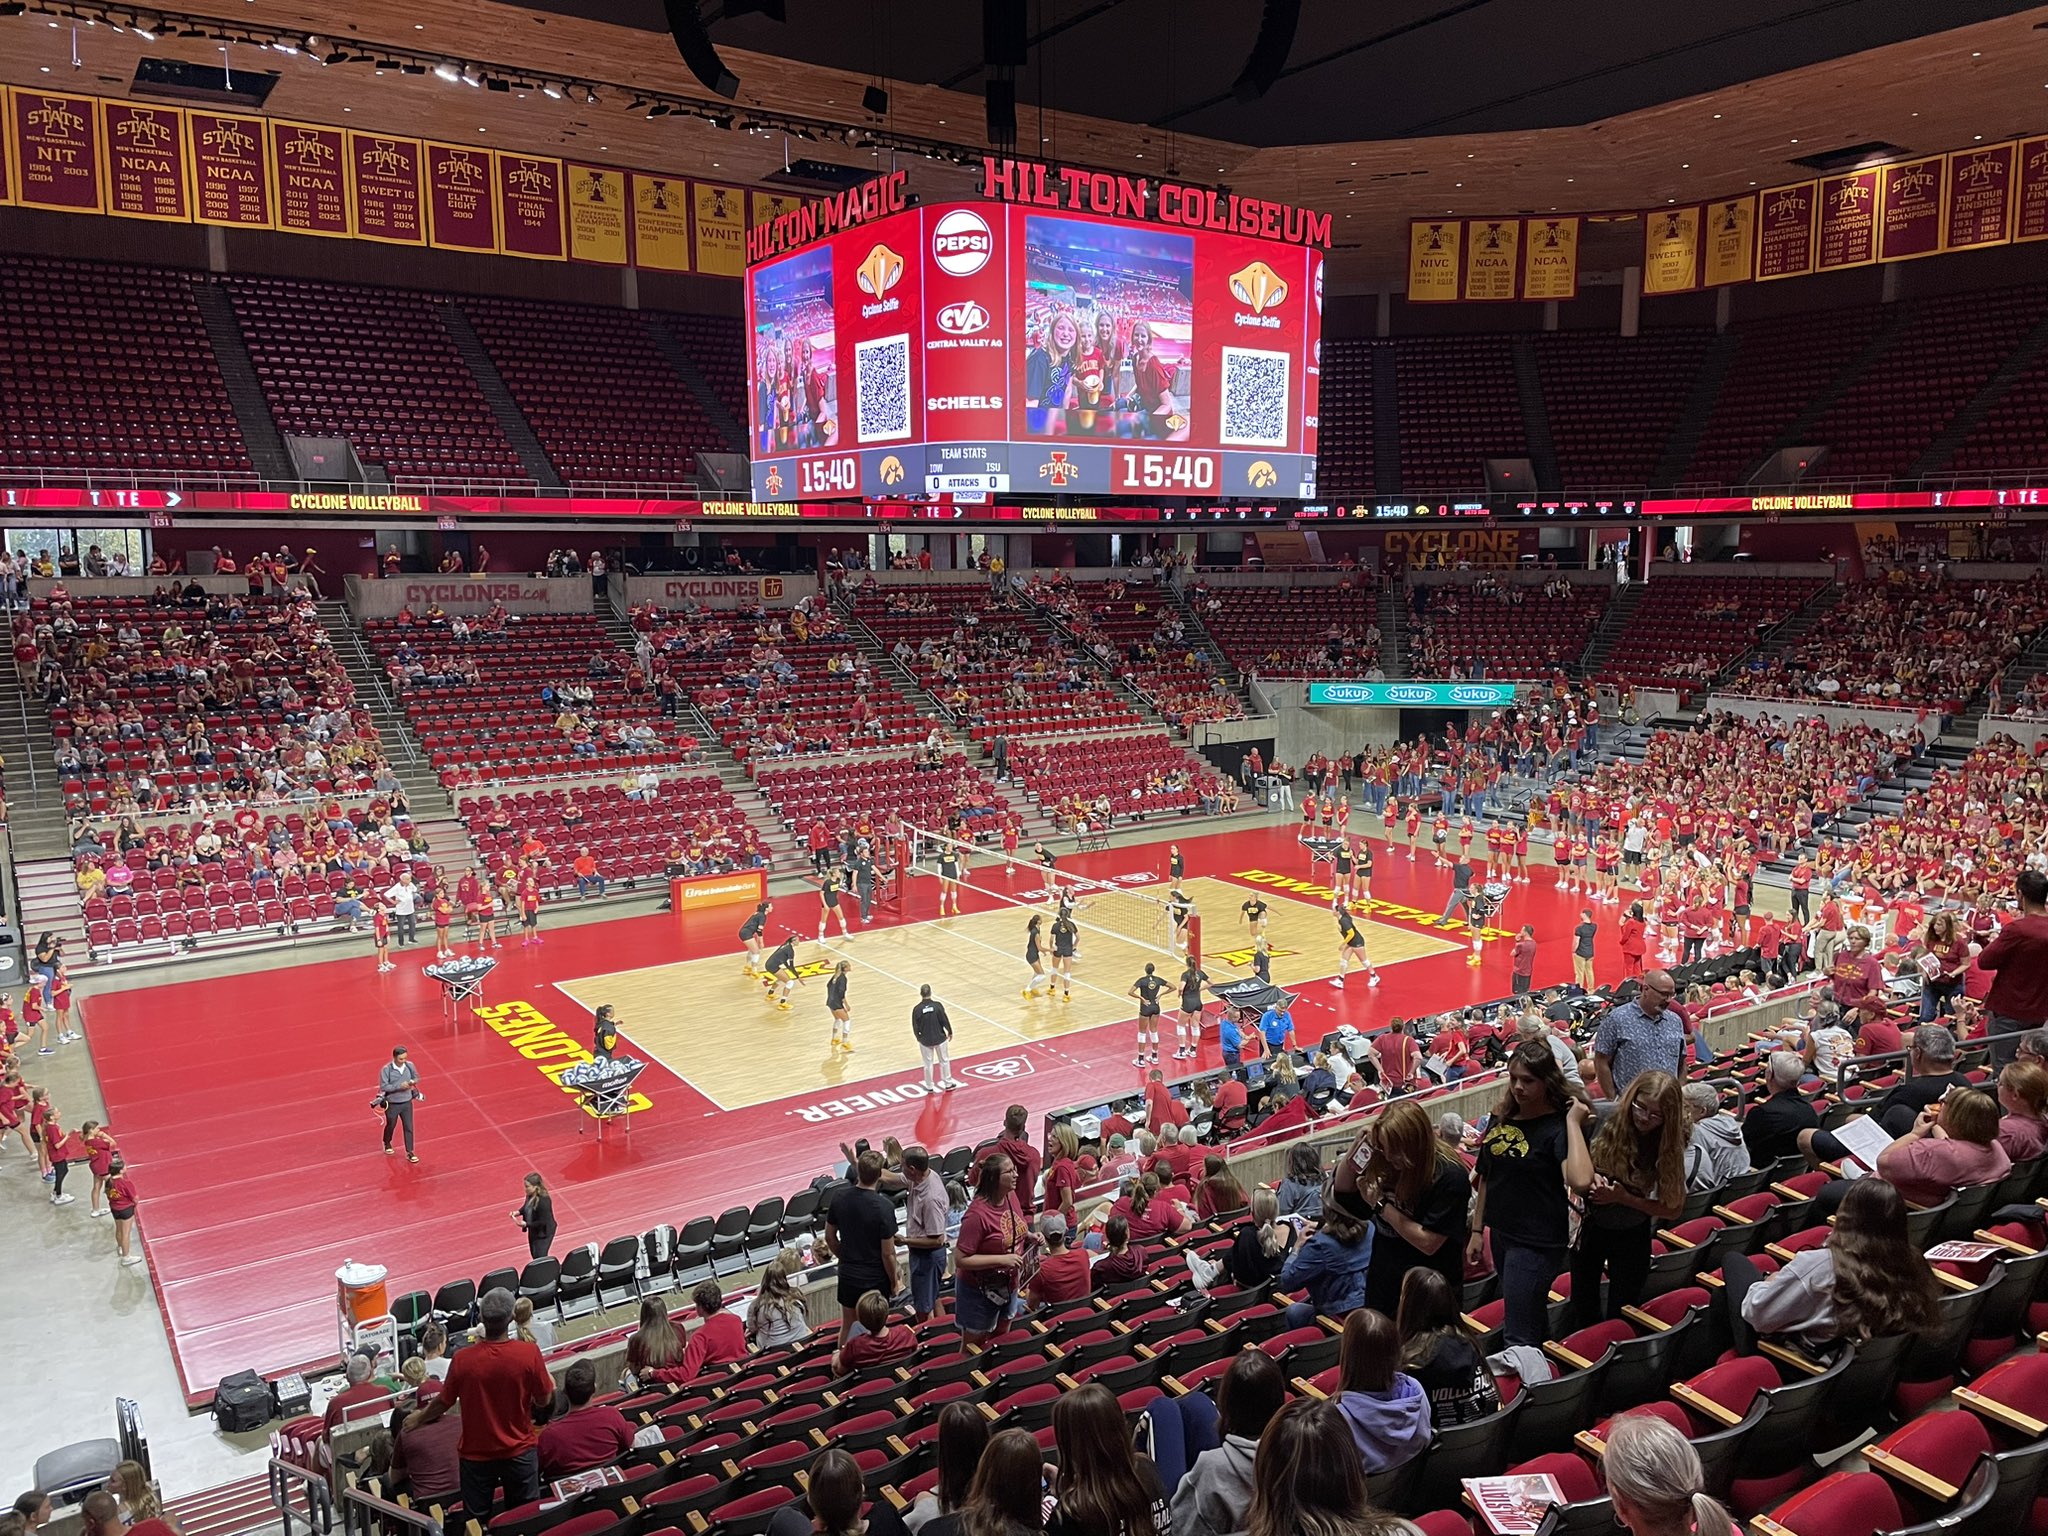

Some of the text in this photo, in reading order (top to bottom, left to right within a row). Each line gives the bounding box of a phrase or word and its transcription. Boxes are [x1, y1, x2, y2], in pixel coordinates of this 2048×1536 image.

[28, 108, 84, 132] STATE
[117, 117, 171, 141] STATE
[202, 129, 255, 151] STATE
[37, 147, 76, 163] NIT
[285, 140, 334, 160] STATE
[121, 157, 171, 172] NCAA
[362, 150, 410, 171] STATE
[64, 167, 88, 176] 2003
[207, 166, 255, 181] NCAA
[438, 161, 482, 180] STATE
[1960, 162, 2003, 181] STATE
[28, 173, 53, 182] 2004
[120, 174, 141, 182] 1944
[289, 175, 335, 190] NCAA
[508, 171, 552, 190] STATE
[1892, 174, 1934, 193] STATE
[238, 185, 259, 193] 1997
[361, 185, 415, 199] SWEET 16
[155, 196, 176, 204] 1992
[205, 191, 259, 203] 2000 2001
[447, 193, 476, 203] ELITE
[1829, 187, 1869, 204] STATE
[1957, 189, 2003, 204] TOP FOUR
[121, 202, 143, 211] 1993
[240, 204, 260, 212] 2012
[286, 200, 309, 208] 2017
[393, 203, 413, 211] 1997
[448, 201, 477, 210] EIGHT
[518, 201, 545, 211] FINAL
[983, 157, 1332, 248] HILTON COLISEUM
[1769, 199, 1806, 216] STATE
[1888, 202, 1936, 215] CONFERENCE
[1956, 198, 2002, 211] FINISHES
[207, 210, 261, 221] 2013 2014
[287, 209, 341, 221] 2022 2023
[364, 209, 385, 217] 2014
[453, 211, 473, 219] 2000
[518, 208, 546, 219] FOUR
[747, 170, 907, 263] HILTON MAGIC
[1825, 213, 1871, 225] CONFERENCE
[1887, 208, 1936, 223] CHAMPIONS
[288, 218, 310, 227] 2024
[365, 217, 415, 229] 2022 2024
[575, 218, 621, 228] CHAMPIONS
[638, 218, 683, 228] CONFERENCE
[1824, 220, 1871, 233] CHAMPIONS
[1889, 223, 1908, 231] 2024
[638, 225, 684, 235] CHAMPIONS
[701, 227, 741, 241] WNIT
[1765, 225, 1808, 236] CONFERENCE
[936, 235, 987, 251] PEPSI
[1764, 231, 1808, 243] CHAMPIONS
[1826, 233, 1844, 241] 1977
[1849, 237, 1867, 245] 1982
[1649, 249, 1693, 260] SWEET 16
[1849, 245, 1866, 253] 2007
[1421, 259, 1448, 268] NIVC
[1476, 259, 1508, 267] NCAA
[1535, 257, 1567, 265] NCAA
[862, 299, 899, 318] Cyclone Selfie
[940, 301, 983, 334] CVA
[1235, 312, 1280, 328] Cyclone Selfie
[927, 339, 1002, 349] CENTRAL VALLEY AG
[928, 396, 1002, 410] SCHEELS
[941, 447, 987, 460] TEAM STATS
[930, 464, 943, 473] IOW
[986, 463, 1001, 472] ISU
[1040, 464, 1078, 479] STATE
[1123, 453, 1214, 488] 15:40
[803, 458, 855, 492] 15:40
[933, 476, 997, 489] 0 ATTACKS 0
[290, 494, 421, 511] CYCLONE VOLLEYBALL
[1752, 495, 1852, 511] CYCLONE VOLLEYBALL
[703, 502, 799, 516] CYCLONE VOLLEYBALL
[1023, 508, 1096, 519] CYCLONE VOLLEYBALL
[1337, 507, 1345, 517] 0
[1376, 505, 1409, 517] 15:40
[1439, 505, 1447, 516] 0
[1385, 530, 1519, 553] CYCLONE
[666, 581, 759, 598] CYCLONES
[1328, 686, 1368, 700] Sukup
[1391, 686, 1431, 700] Sukup
[1454, 686, 1495, 701] Sukup
[710, 885, 742, 894] Interstate
[1231, 869, 1345, 900] IOWA
[360, 1329, 390, 1339] GATORADE
